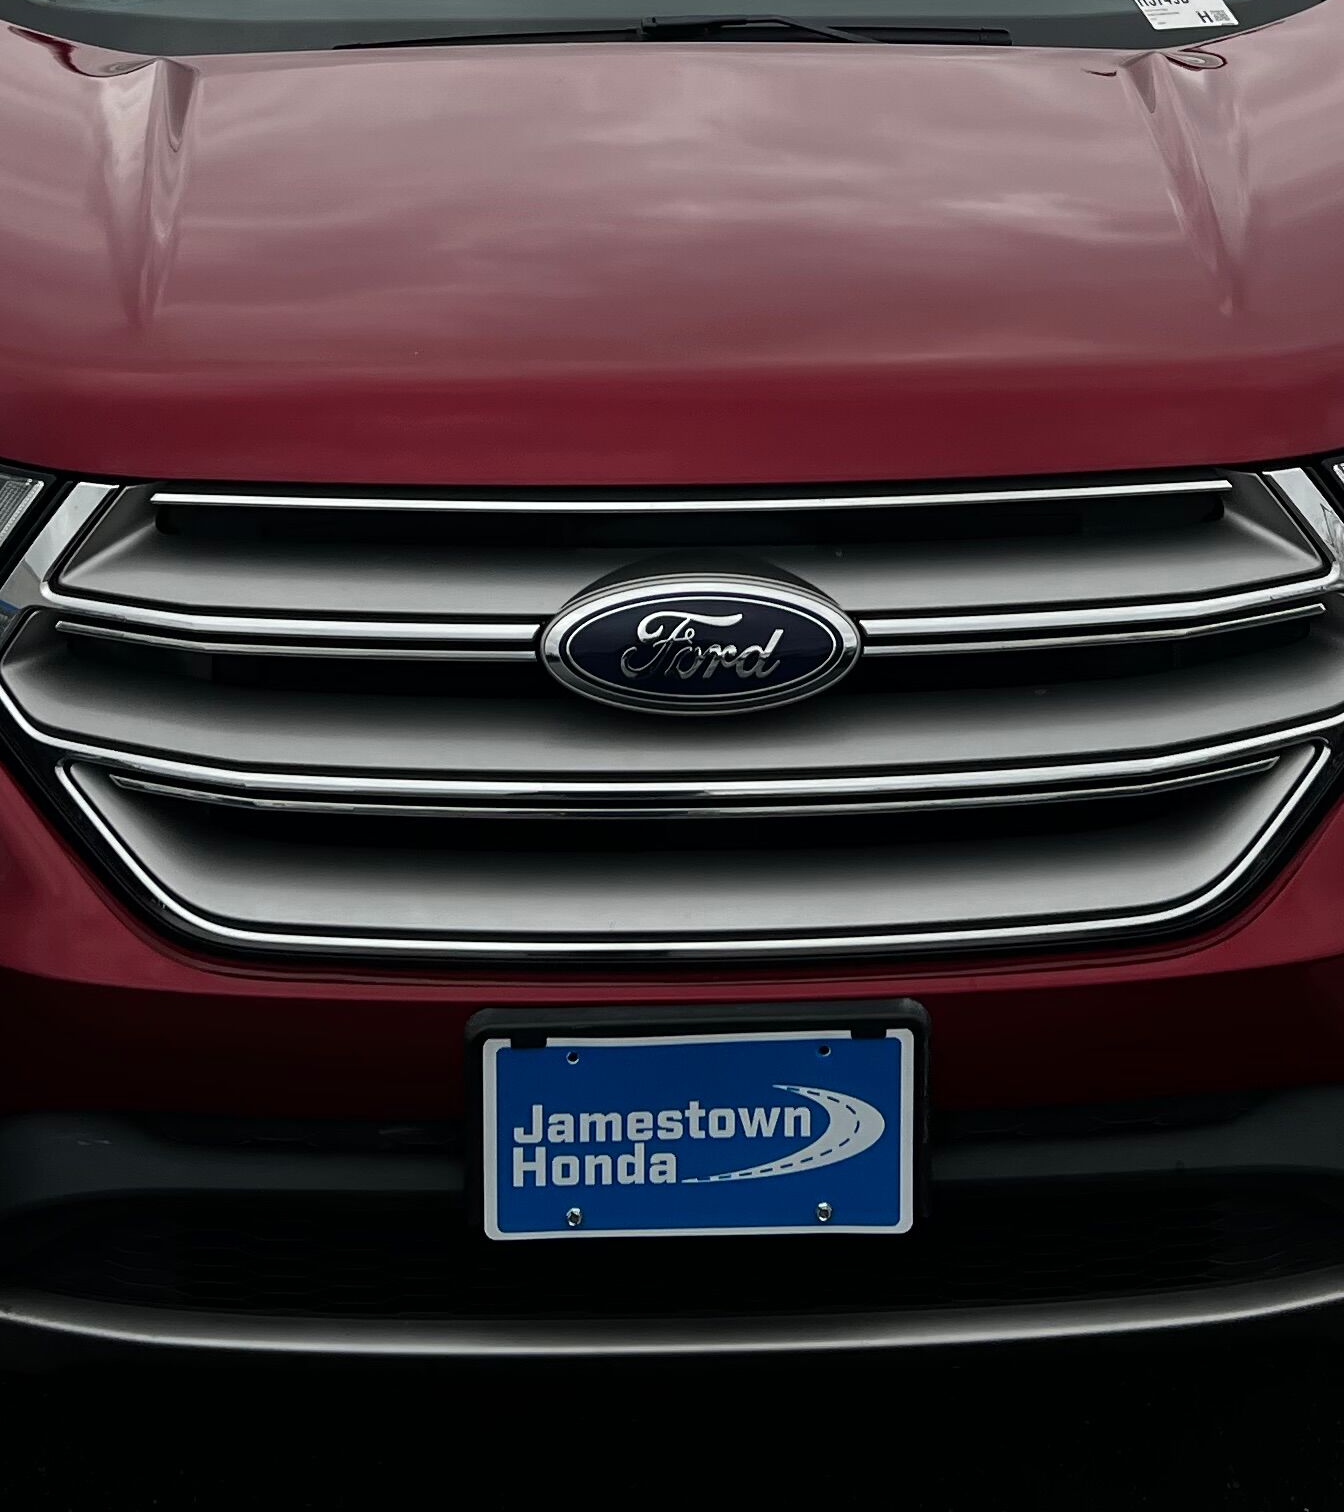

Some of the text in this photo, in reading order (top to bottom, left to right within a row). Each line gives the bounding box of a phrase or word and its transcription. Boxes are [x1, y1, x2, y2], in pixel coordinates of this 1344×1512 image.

[1197, 10, 1214, 24] H
[620, 609, 785, 680] Ford
[513, 1101, 812, 1145] Jamestown
[512, 1143, 678, 1188] Honda
